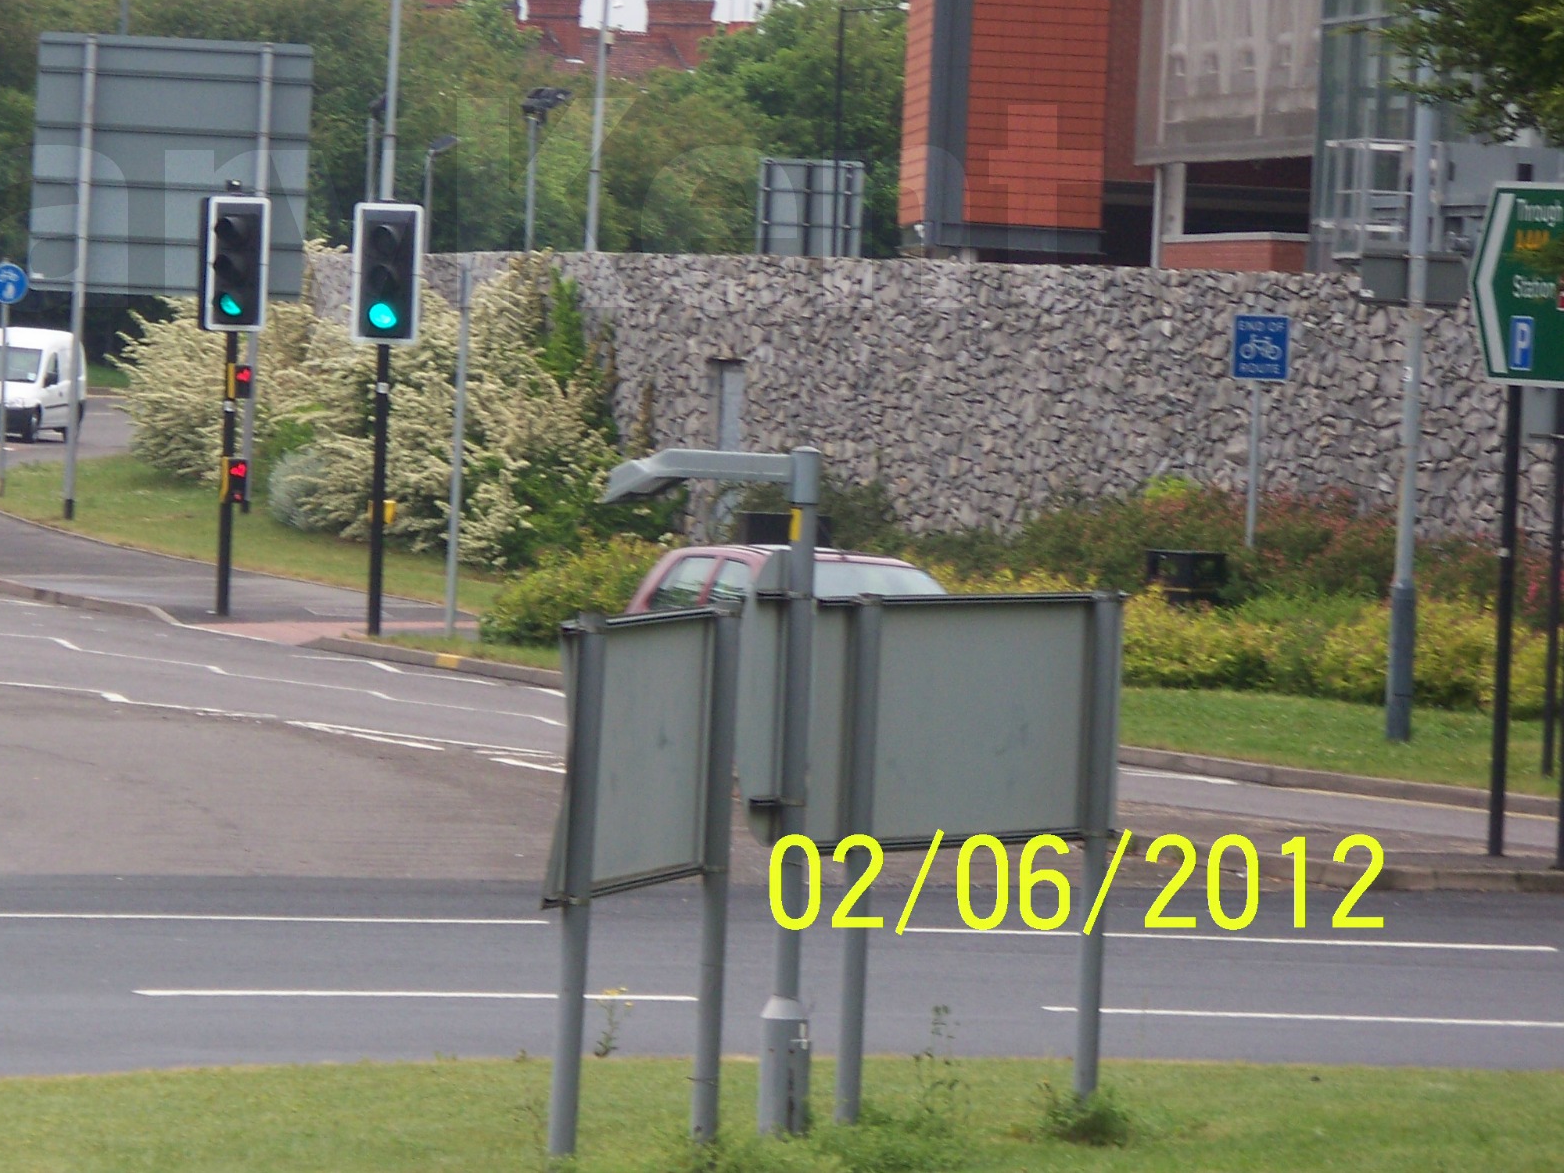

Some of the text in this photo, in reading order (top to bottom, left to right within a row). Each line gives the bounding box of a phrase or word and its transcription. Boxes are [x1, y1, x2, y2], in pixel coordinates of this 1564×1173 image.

[1516, 198, 1563, 227] Through
[1513, 275, 1557, 298] Station
[1238, 320, 1285, 332] END OF
[1516, 322, 1530, 365] P
[1239, 362, 1280, 375] ROUTE
